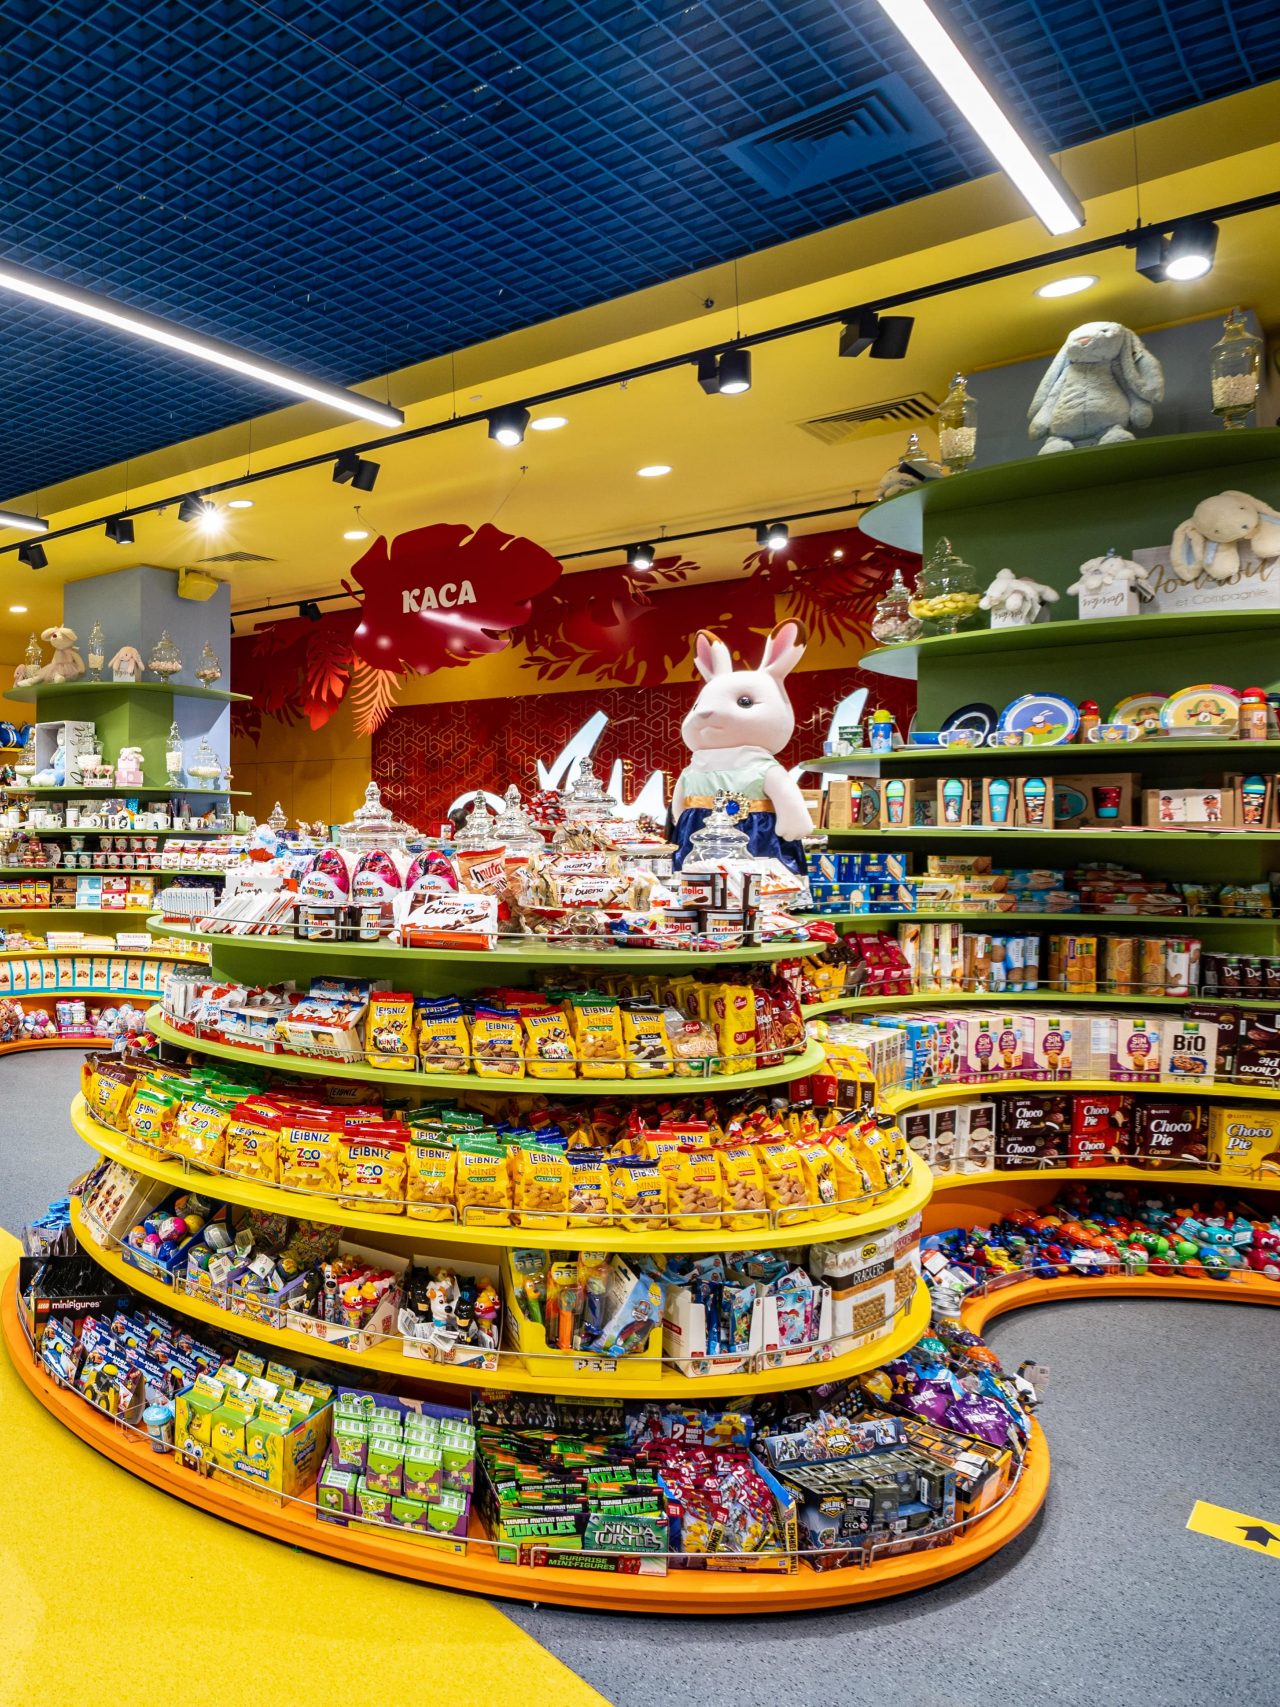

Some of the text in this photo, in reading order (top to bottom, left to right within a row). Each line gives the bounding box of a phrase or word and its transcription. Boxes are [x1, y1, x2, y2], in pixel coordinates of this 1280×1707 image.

[402, 580, 477, 614] КАСА
[575, 887, 604, 896] bueno
[423, 904, 475, 915] bueno
[582, 1006, 615, 1016] LEIBNIZ
[530, 1015, 562, 1027] LEIBNIZ
[631, 1013, 661, 1024] LEIBNIZ
[486, 1022, 515, 1032] LEIBNIZ
[1258, 1057, 1280, 1067] Pie
[1240, 1065, 1280, 1077] Choco
[327, 1086, 359, 1098] LEIBNIZ
[1016, 1107, 1044, 1119] Choco
[1083, 1105, 1110, 1116] Choco
[134, 1117, 152, 1131] ZOO
[1016, 1118, 1032, 1130] Pie
[1083, 1116, 1099, 1127] Pie
[1149, 1119, 1193, 1133] Choco
[289, 1128, 331, 1143] LEIBNIZ
[1226, 1123, 1274, 1138] Choco
[1078, 1140, 1106, 1151] Choco
[1149, 1133, 1174, 1146] Pie
[1227, 1137, 1253, 1151] Pie
[296, 1147, 321, 1160] ZOO
[348, 1146, 392, 1160] LEIBNIZ
[417, 1147, 451, 1160] LEIBNIZ
[1006, 1143, 1036, 1154] Choco
[464, 1154, 500, 1167] LEIBNIZ
[529, 1152, 564, 1165] LEIBNIZ
[1006, 1154, 1023, 1165] Pie
[1078, 1151, 1093, 1162] Pie
[356, 1163, 384, 1177] ZOO
[467, 1167, 497, 1177] MINIS
[572, 1163, 602, 1175] LEIBNIZ
[636, 1182, 662, 1190] MINIS
[853, 1262, 885, 1285] CRACKERS
[37, 1300, 100, 1310] LEGO minifigures
[574, 1359, 618, 1373] PEZ
[672, 1423, 685, 1440] 2
[717, 1455, 725, 1471] 2
[601, 1502, 659, 1515] TURTLES
[503, 1515, 575, 1526] TEENAGE MUTANT NINJA
[504, 1521, 578, 1538] TURTLES
[604, 1524, 658, 1537] NINJA
[592, 1531, 666, 1548] TURTLES
[548, 1559, 616, 1571] MINI-FIGURES
[559, 1554, 608, 1564] SURPRISE
